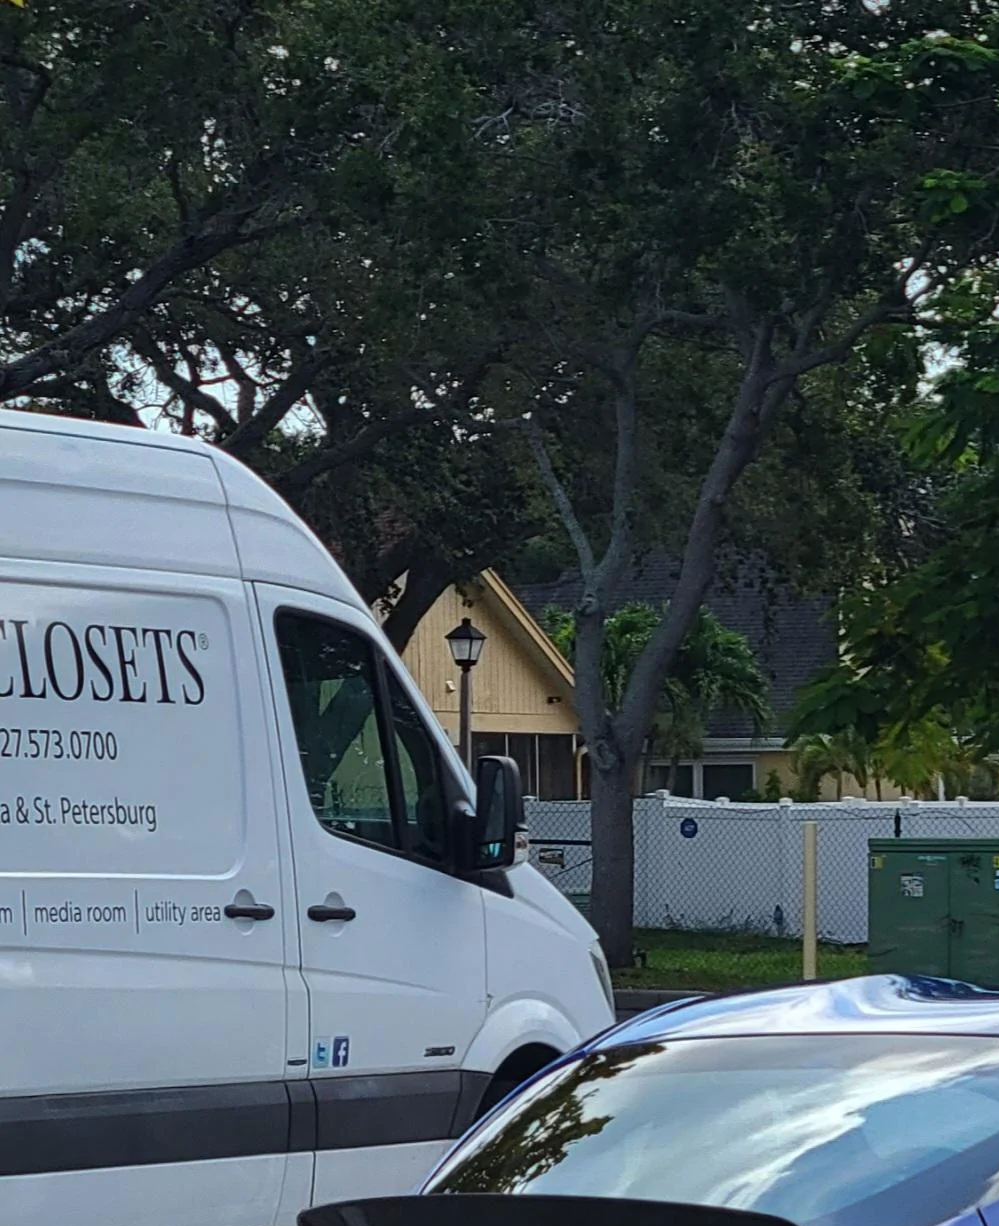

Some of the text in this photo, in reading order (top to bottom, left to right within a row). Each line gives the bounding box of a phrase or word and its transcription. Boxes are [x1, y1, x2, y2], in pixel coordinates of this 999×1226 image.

[16, 796, 30, 825] &
[33, 796, 57, 825] St.
[60, 796, 157, 833] Petersburg
[34, 901, 82, 923] media
[87, 905, 127, 923] room
[146, 901, 221, 926] utility area
